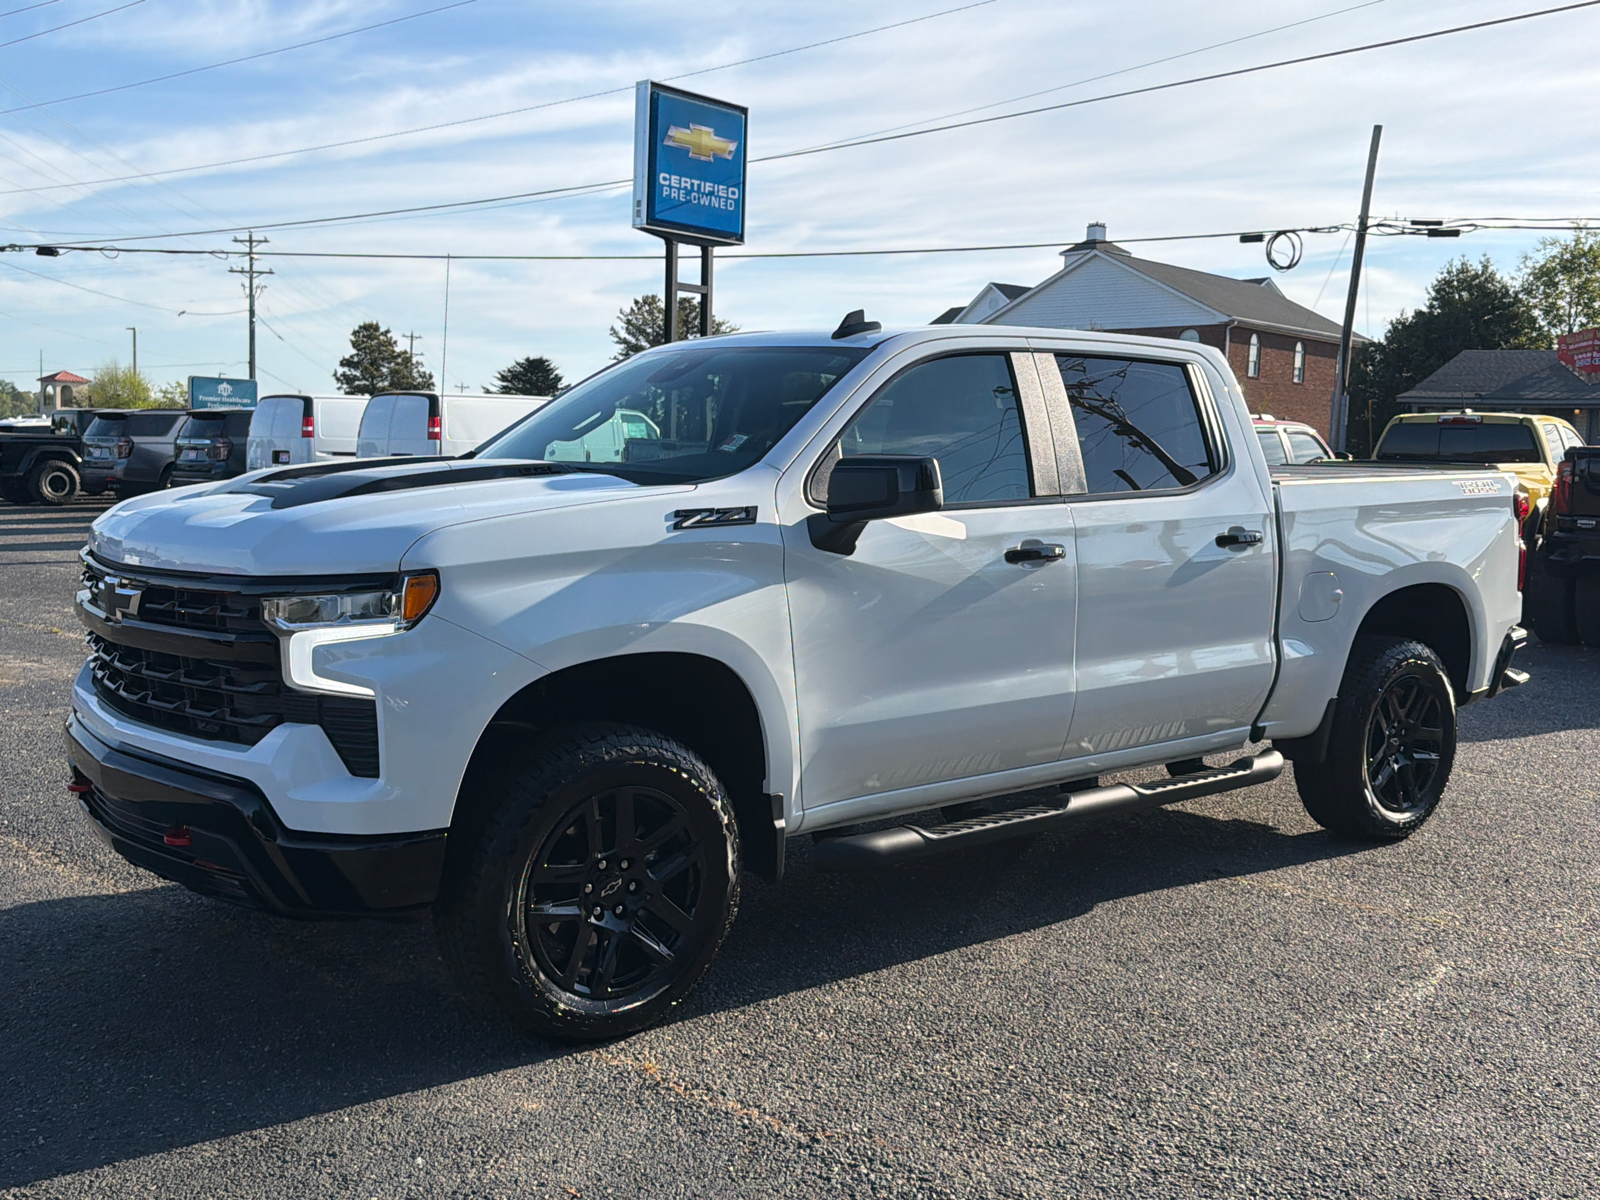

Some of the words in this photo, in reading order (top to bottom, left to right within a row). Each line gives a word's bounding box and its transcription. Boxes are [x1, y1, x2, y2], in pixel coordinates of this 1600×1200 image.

[659, 172, 739, 199] CERTIFIED
[662, 187, 735, 211] PRE-OWNED
[199, 394, 221, 402] Premier
[222, 396, 251, 404] Healthcare
[1452, 480, 1501, 489] TRAIL
[1462, 487, 1498, 495] BOSS
[666, 505, 758, 531] Z71
